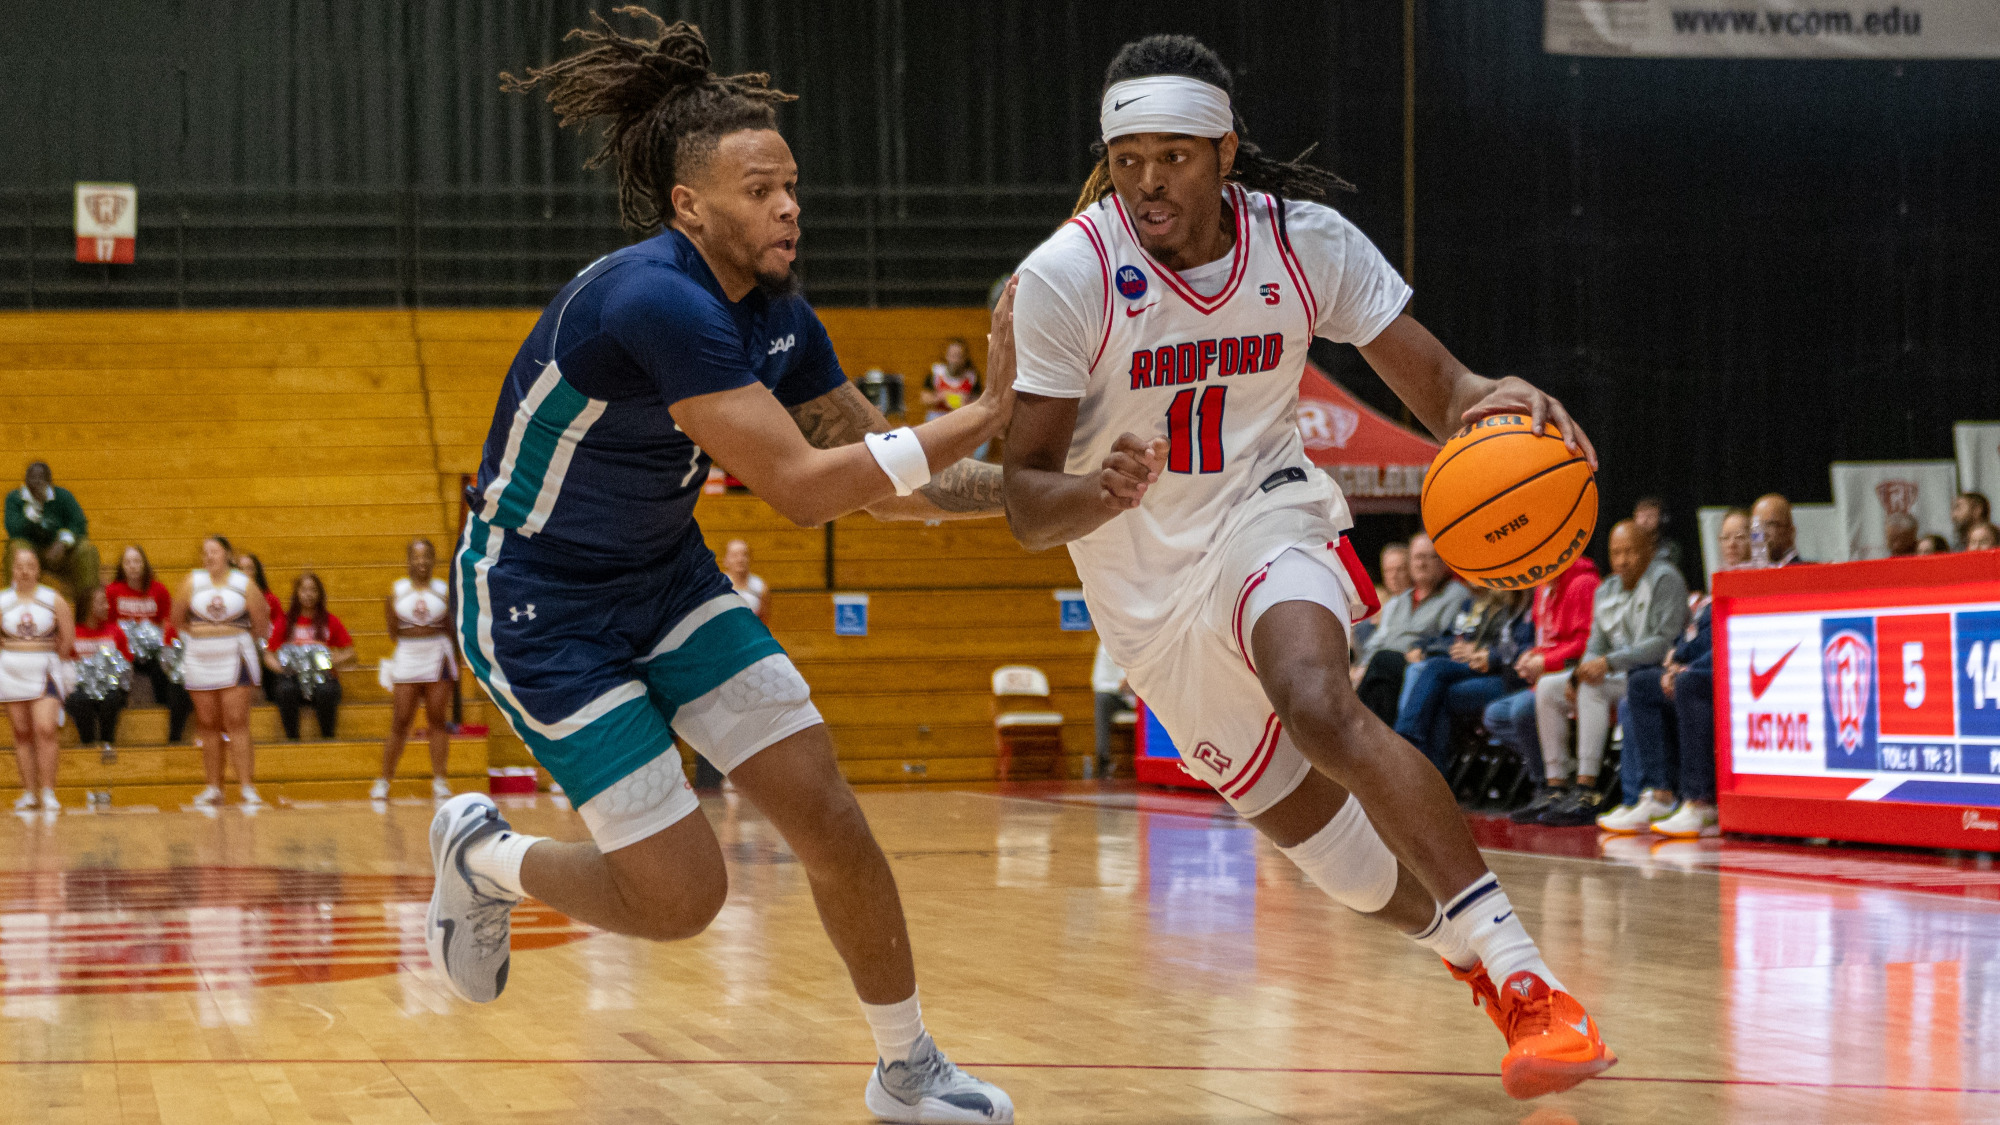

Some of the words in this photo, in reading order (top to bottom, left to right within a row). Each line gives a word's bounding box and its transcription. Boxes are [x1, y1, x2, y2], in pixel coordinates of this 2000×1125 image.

[1672, 7, 1922, 36] www.vcom.edu
[96, 236, 115, 261] 17
[1119, 269, 1139, 282] VA
[1129, 332, 1284, 390] RADFORD
[1165, 385, 1228, 474] 11
[1496, 514, 1529, 540] NFHS
[1478, 528, 1587, 589] Wilson
[1902, 641, 1926, 709] 5
[1965, 639, 2000, 709] 14
